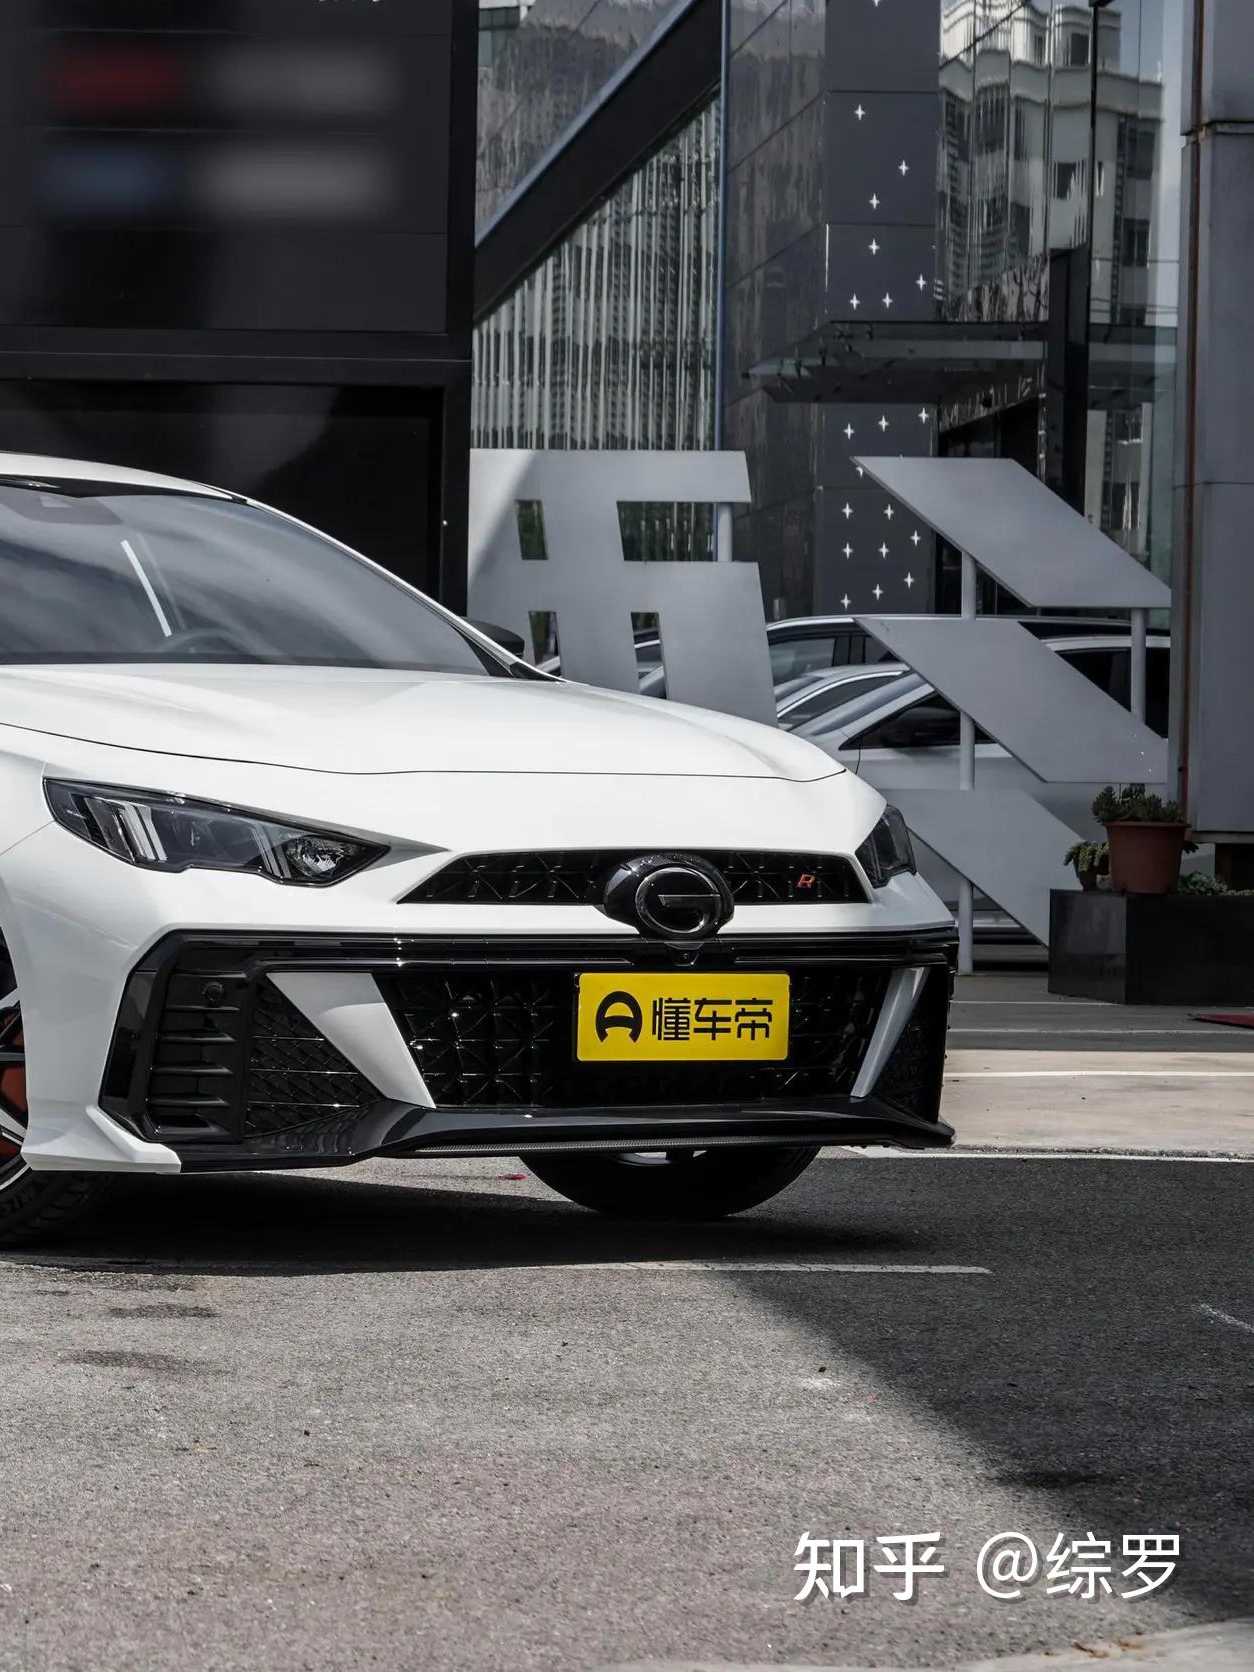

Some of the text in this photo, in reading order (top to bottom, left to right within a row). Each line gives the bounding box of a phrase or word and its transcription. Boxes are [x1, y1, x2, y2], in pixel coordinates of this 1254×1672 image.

[797, 874, 816, 888] R
[652, 997, 773, 1041] 懂车帝
